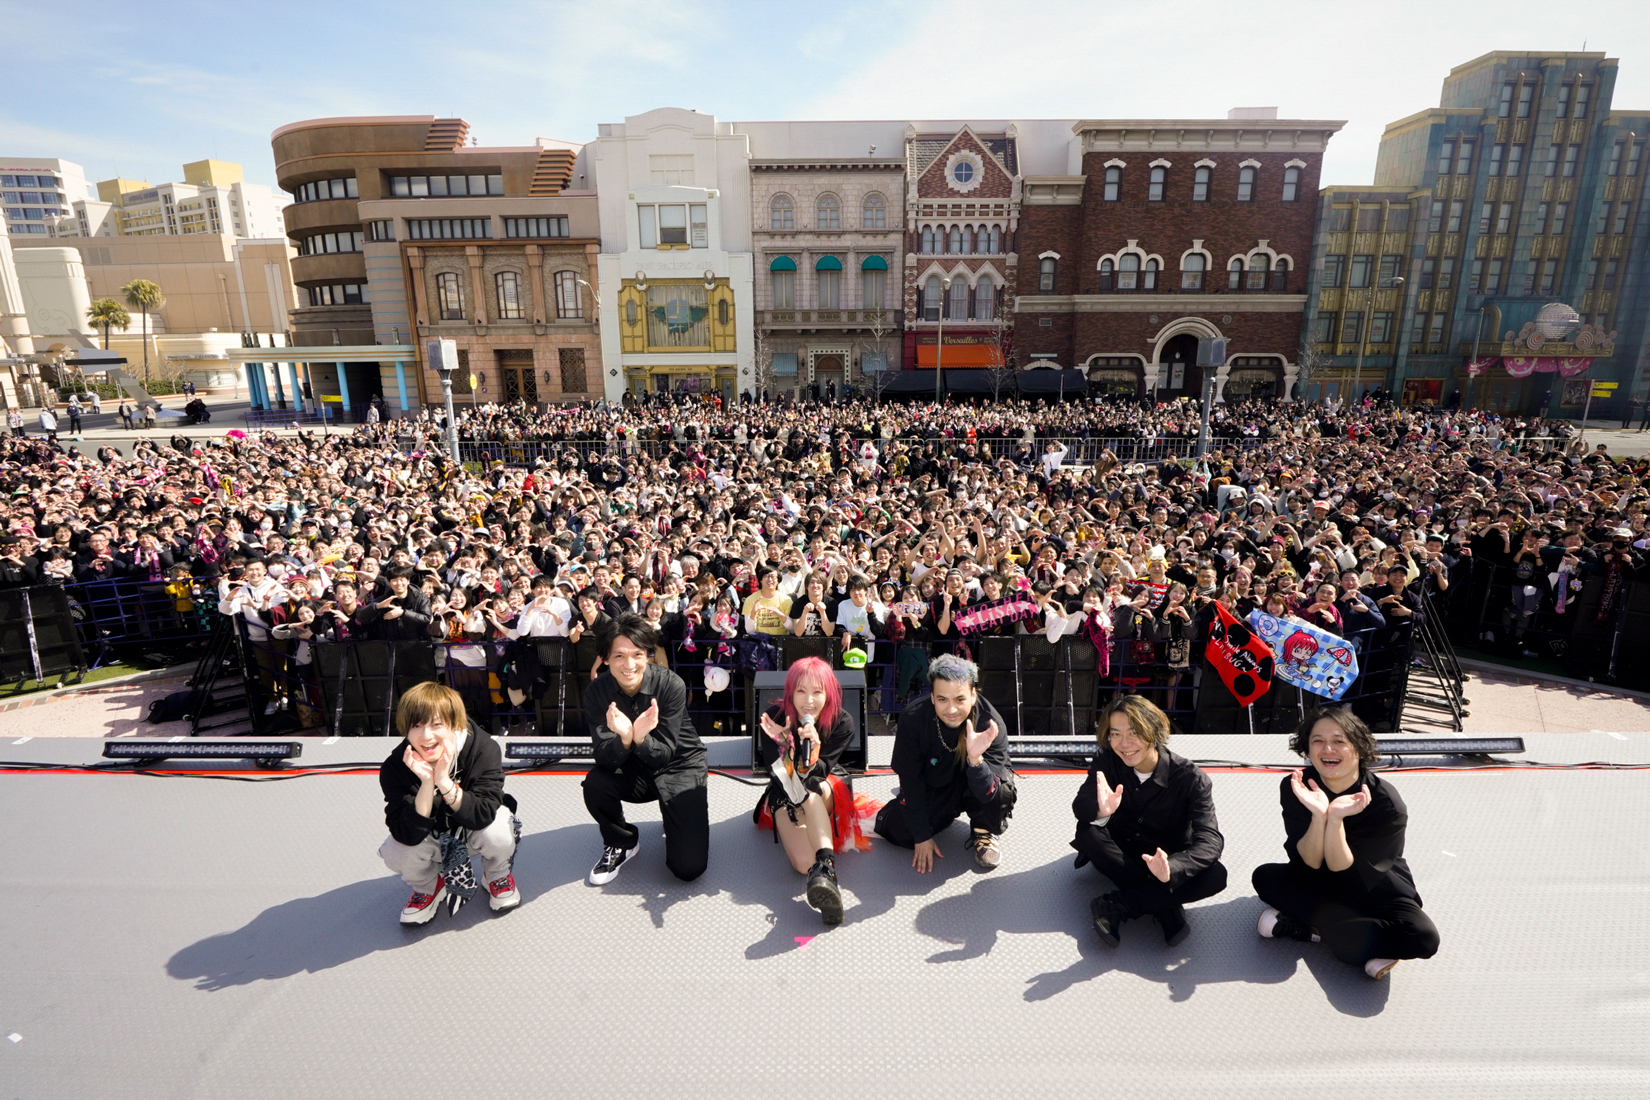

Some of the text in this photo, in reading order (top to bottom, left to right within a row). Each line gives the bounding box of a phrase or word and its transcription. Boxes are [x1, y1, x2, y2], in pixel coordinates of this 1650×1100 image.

[635, 262, 714, 270] PAN PACIFIC AIR
[944, 336, 978, 344] Versailles
[976, 602, 1017, 623] LiSA
[960, 608, 1036, 636] GREAT DAY
